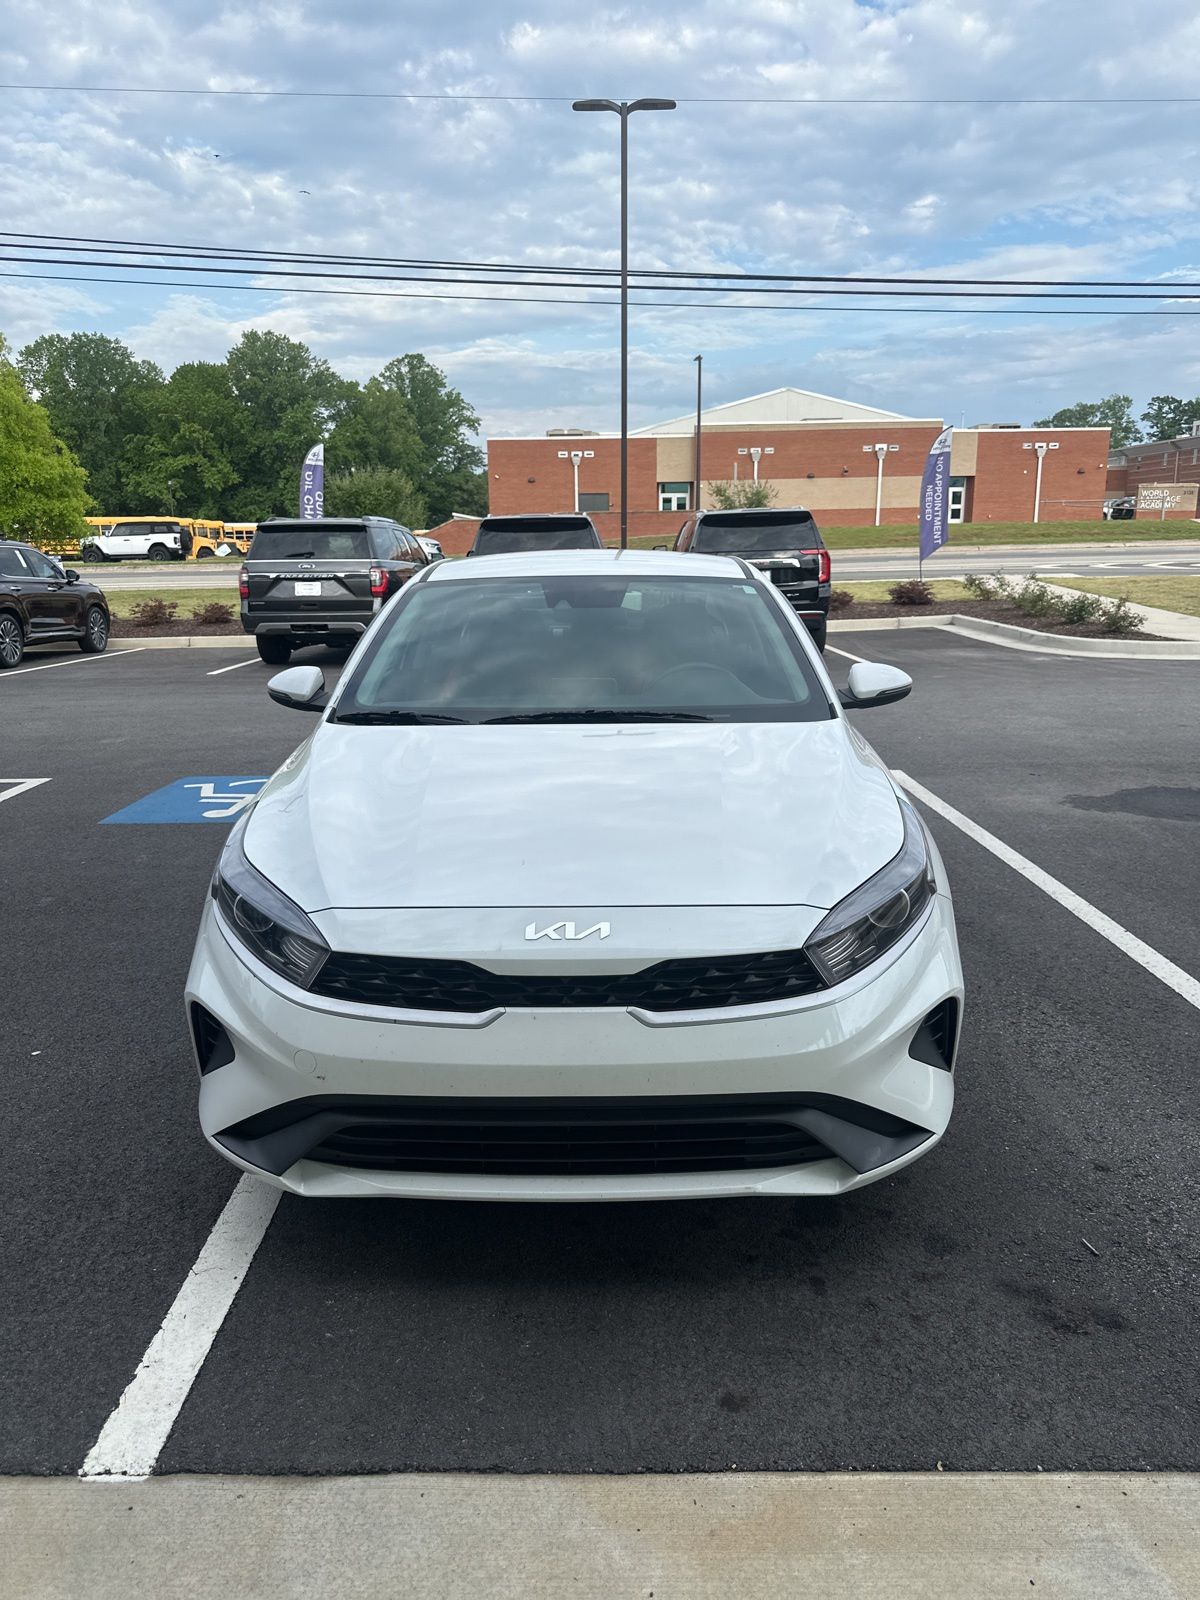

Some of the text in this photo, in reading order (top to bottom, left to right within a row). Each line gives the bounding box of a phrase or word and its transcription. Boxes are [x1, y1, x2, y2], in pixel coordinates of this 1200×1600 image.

[936, 456, 944, 472] NO
[925, 485, 933, 521] NEEDED
[933, 474, 943, 545] APPOINTMENT
[525, 921, 611, 940] KIA
